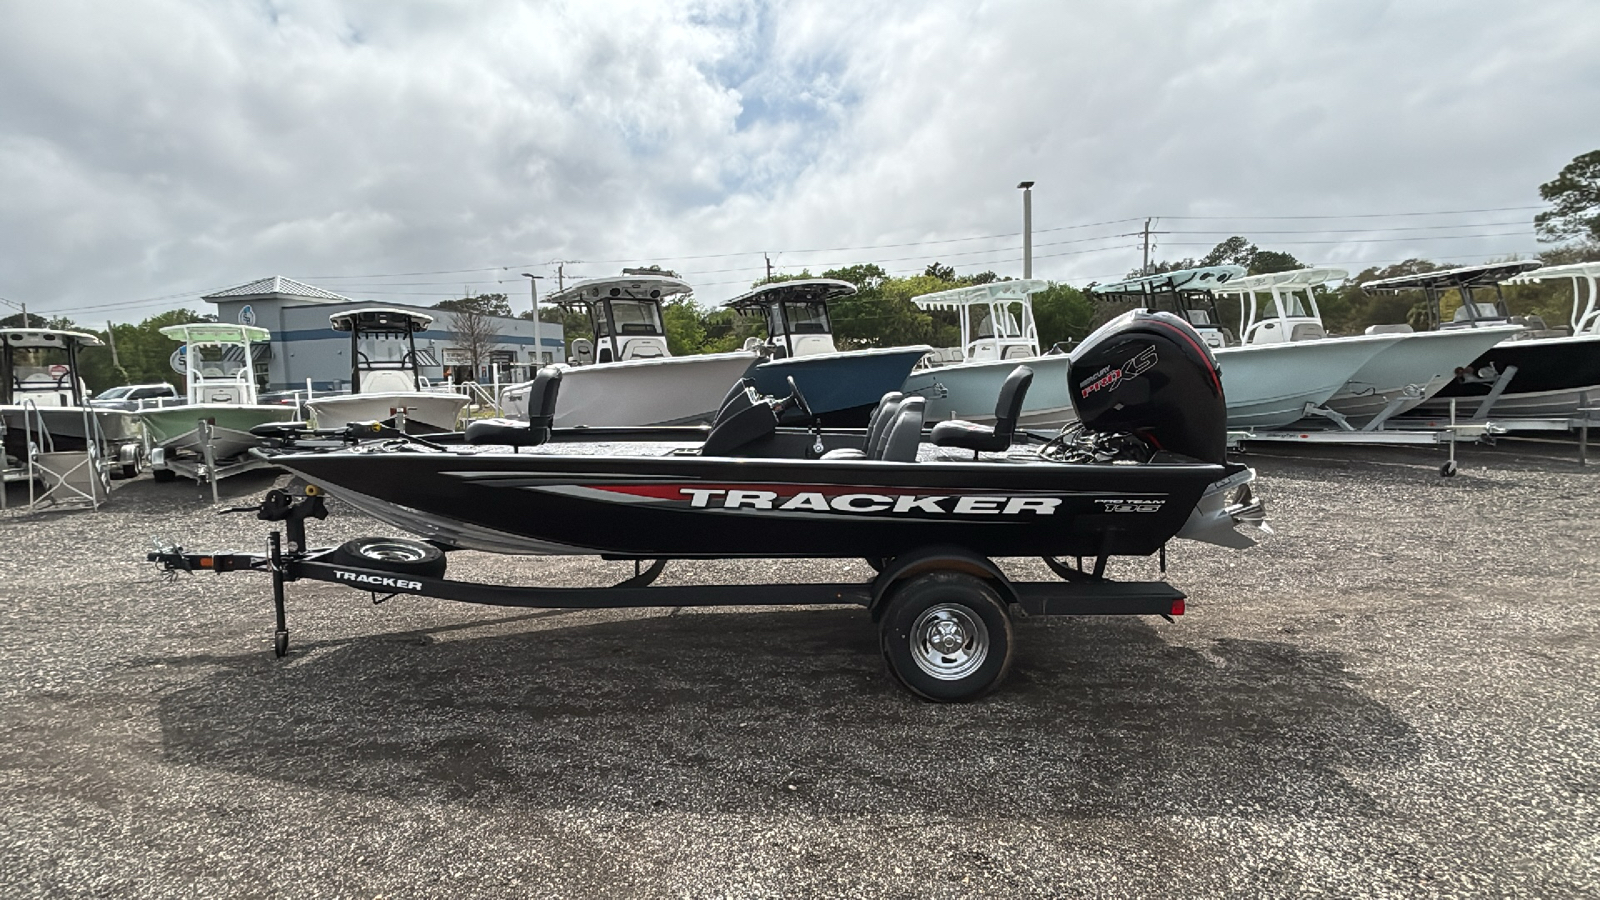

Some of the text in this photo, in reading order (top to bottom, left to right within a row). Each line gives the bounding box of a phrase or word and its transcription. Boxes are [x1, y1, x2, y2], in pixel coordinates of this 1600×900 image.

[1080, 365, 1110, 388] MERCURY
[680, 488, 1062, 514] TRACKER
[1105, 504, 1161, 512] 195
[333, 570, 422, 590] TRACKER
